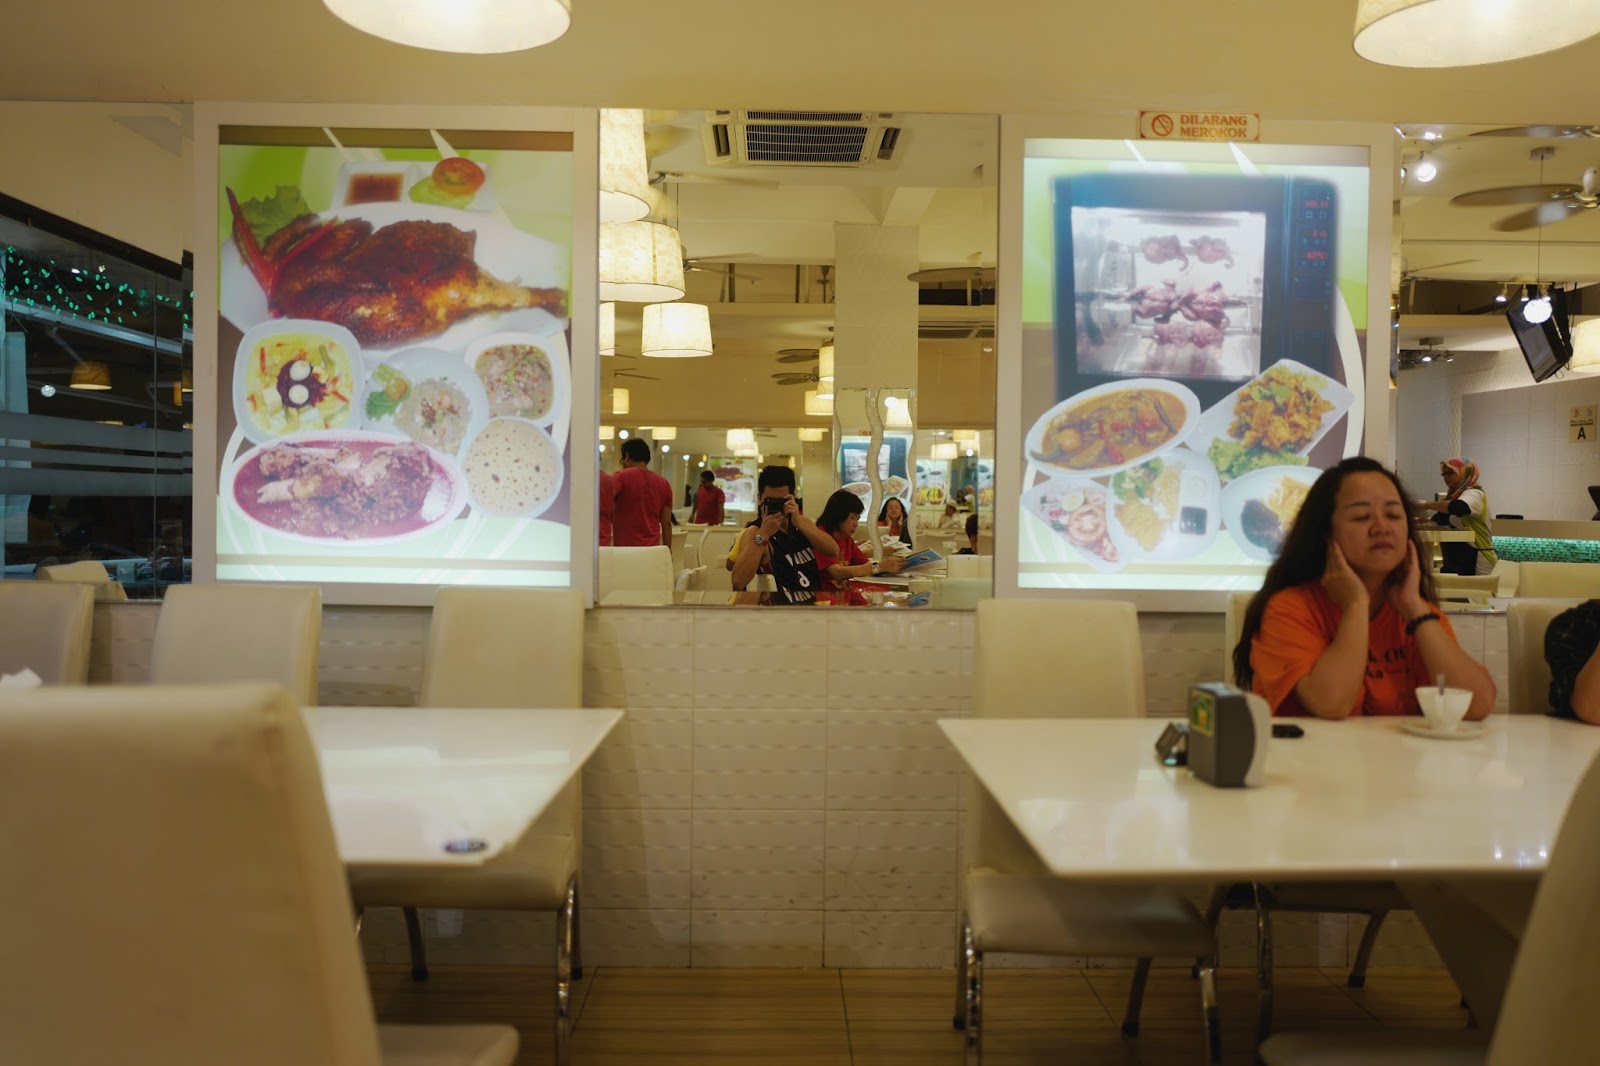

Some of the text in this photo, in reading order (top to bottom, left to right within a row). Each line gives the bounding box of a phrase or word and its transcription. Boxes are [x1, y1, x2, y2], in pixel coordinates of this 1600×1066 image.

[1179, 114, 1248, 126] DILARANG
[1179, 127, 1248, 139] MEROKOK
[1577, 426, 1587, 440] A
